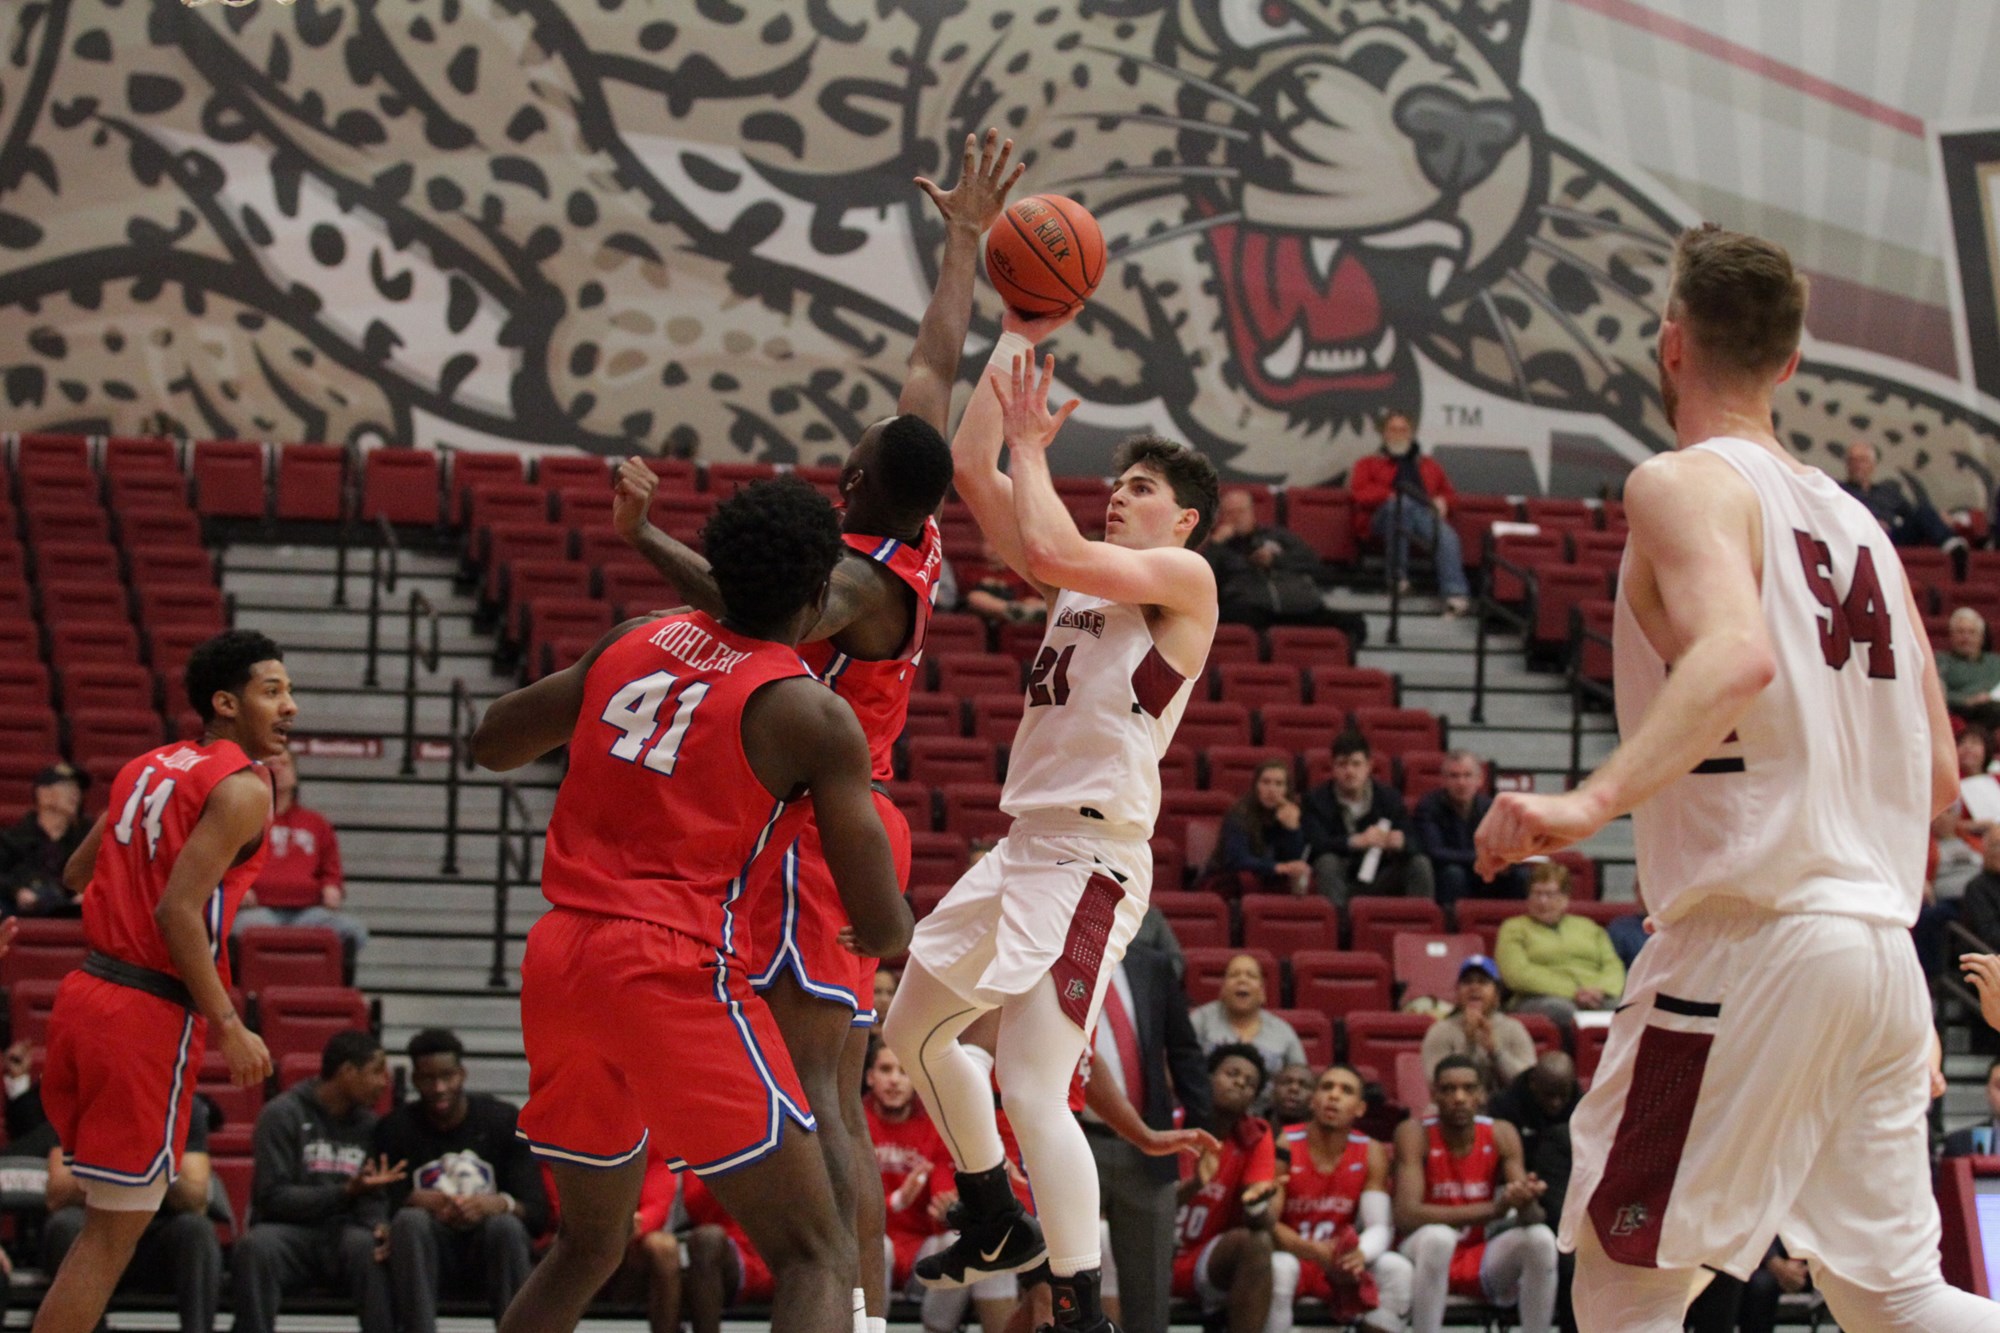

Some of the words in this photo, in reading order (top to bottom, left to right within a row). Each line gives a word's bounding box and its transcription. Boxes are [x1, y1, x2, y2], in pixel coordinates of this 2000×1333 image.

[1033, 218, 1070, 262] ROCK
[1442, 404, 1482, 427] TM
[1792, 527, 1896, 680] 54
[1029, 644, 1076, 707] 21
[600, 668, 711, 777] 41
[114, 765, 176, 861] 14
